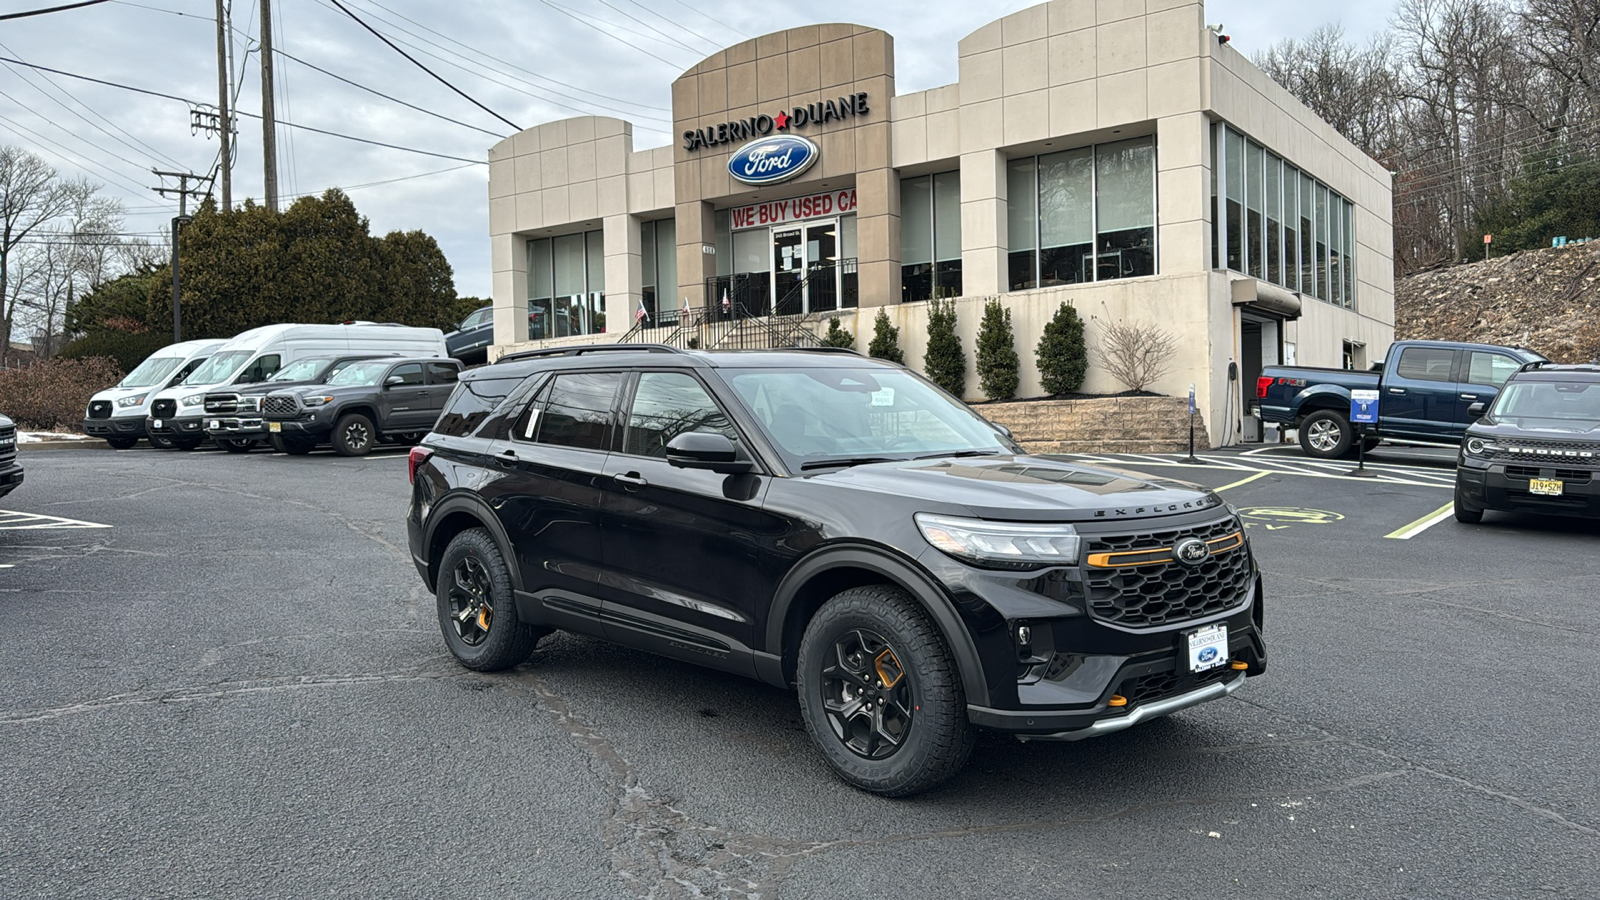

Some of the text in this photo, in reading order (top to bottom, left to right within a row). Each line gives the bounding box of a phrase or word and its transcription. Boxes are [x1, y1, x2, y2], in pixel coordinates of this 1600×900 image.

[683, 92, 869, 151] SALERNO DUANE
[744, 145, 793, 175] Ford
[732, 206, 755, 228] WE
[759, 201, 789, 224] BUY
[792, 194, 833, 219] USED
[1508, 447, 1592, 457] BRONCO
[1094, 497, 1213, 517] EXPLORER
[1187, 545, 1205, 559] Ford
[1201, 649, 1215, 661] Ford
